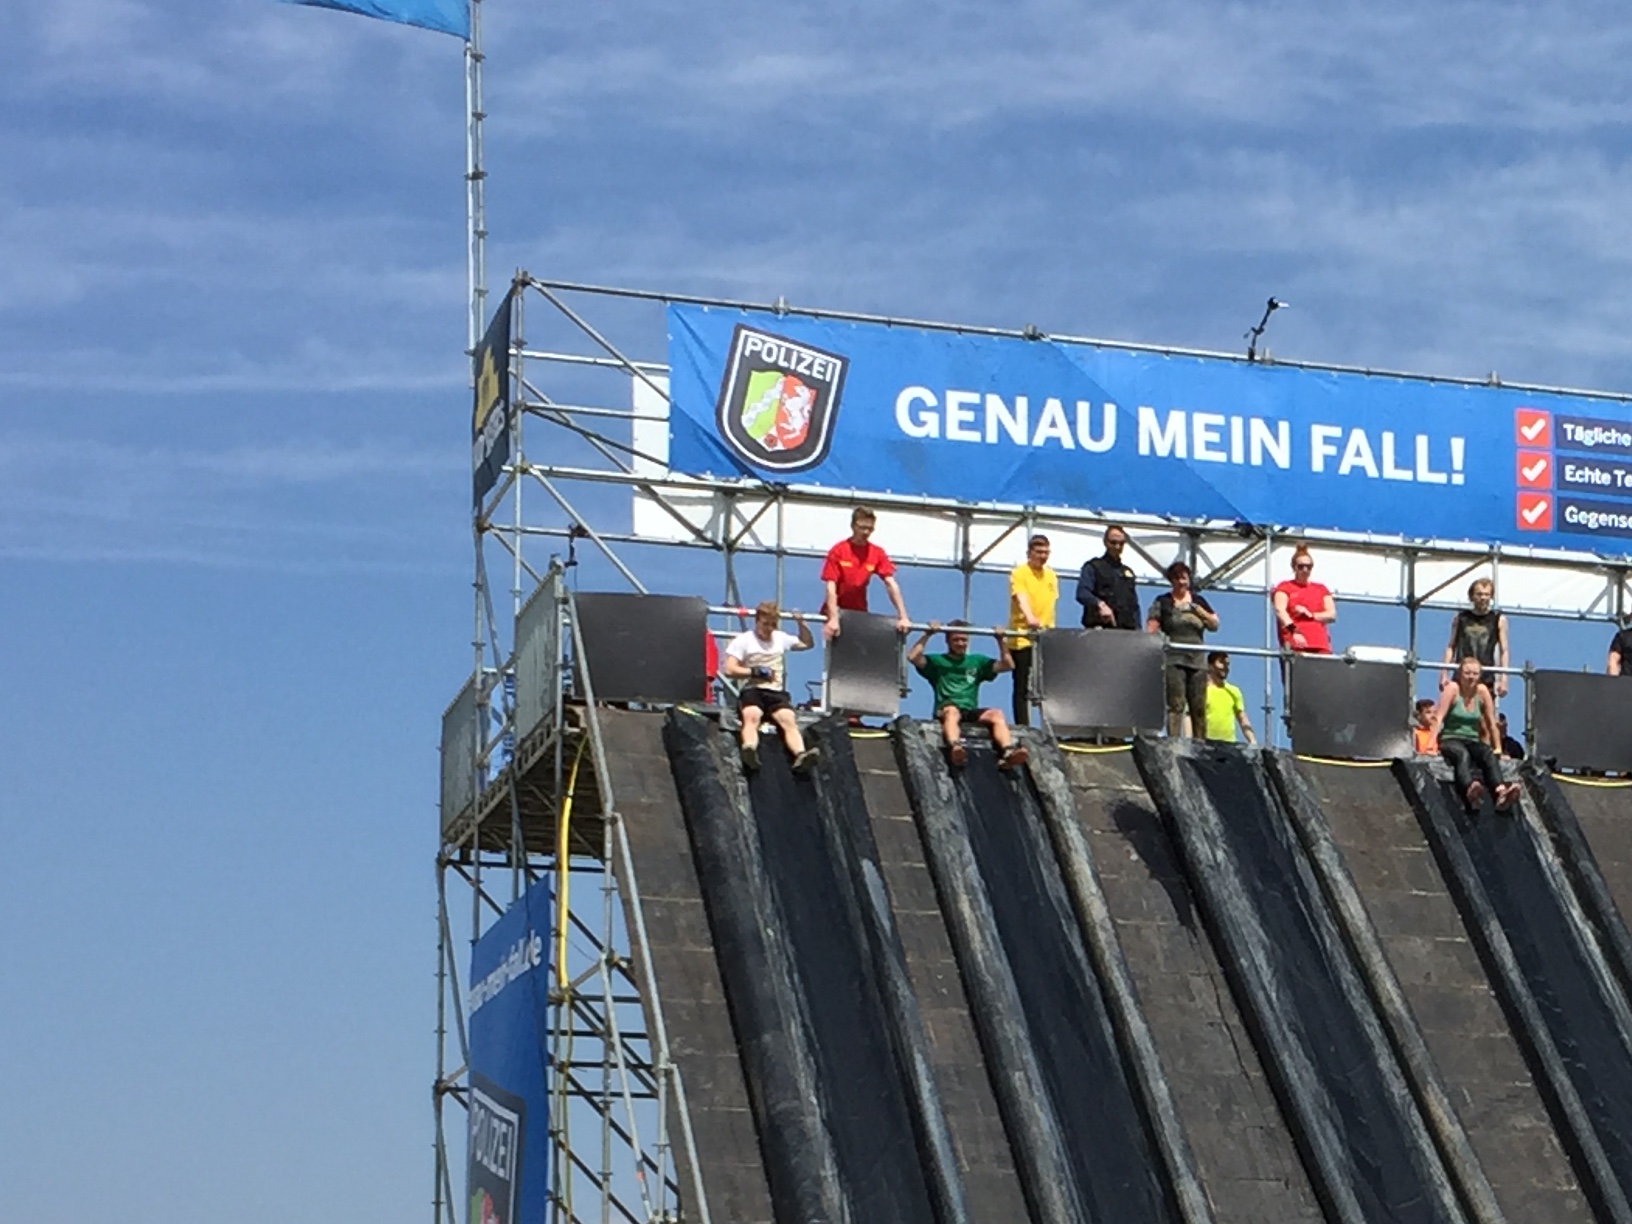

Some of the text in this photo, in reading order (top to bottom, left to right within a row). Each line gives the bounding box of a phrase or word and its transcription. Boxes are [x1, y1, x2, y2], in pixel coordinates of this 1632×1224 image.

[744, 336, 835, 383] POLIZEI
[895, 385, 1466, 486] GENAU MEIN FALL!
[1562, 423, 1632, 447] Tägliche
[1564, 464, 1612, 486] Echte
